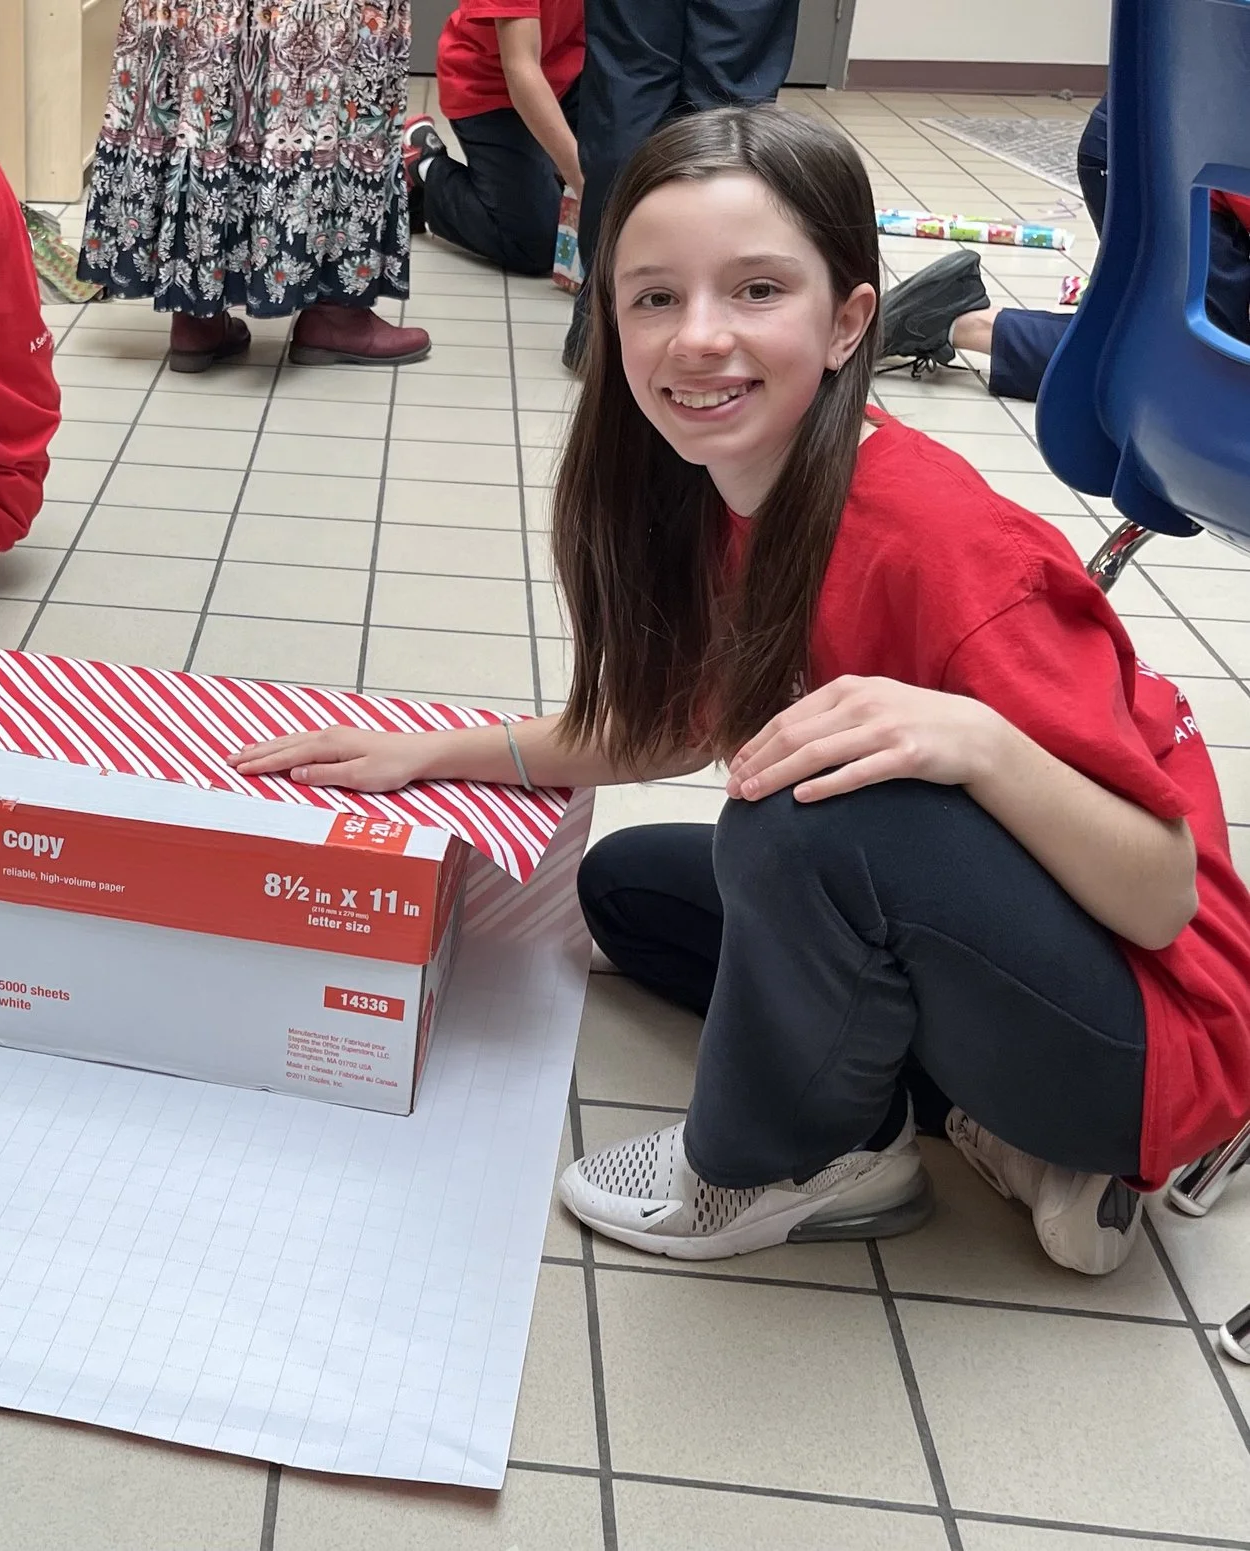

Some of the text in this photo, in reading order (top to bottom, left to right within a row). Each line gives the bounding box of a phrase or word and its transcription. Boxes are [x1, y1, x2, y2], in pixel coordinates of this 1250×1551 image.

[343, 819, 366, 833] 92
[369, 823, 391, 837] 20
[3, 829, 65, 859] copy
[3, 867, 125, 893] reliable, high-volume paper
[315, 889, 331, 905] in
[370, 888, 398, 914] 11
[403, 901, 420, 917] in
[308, 914, 371, 933] letter size
[30, 986, 70, 1001] sheets
[341, 993, 388, 1013] 14336
[300, 1044, 323, 1054] Staples
[286, 1061, 303, 1069] Made
